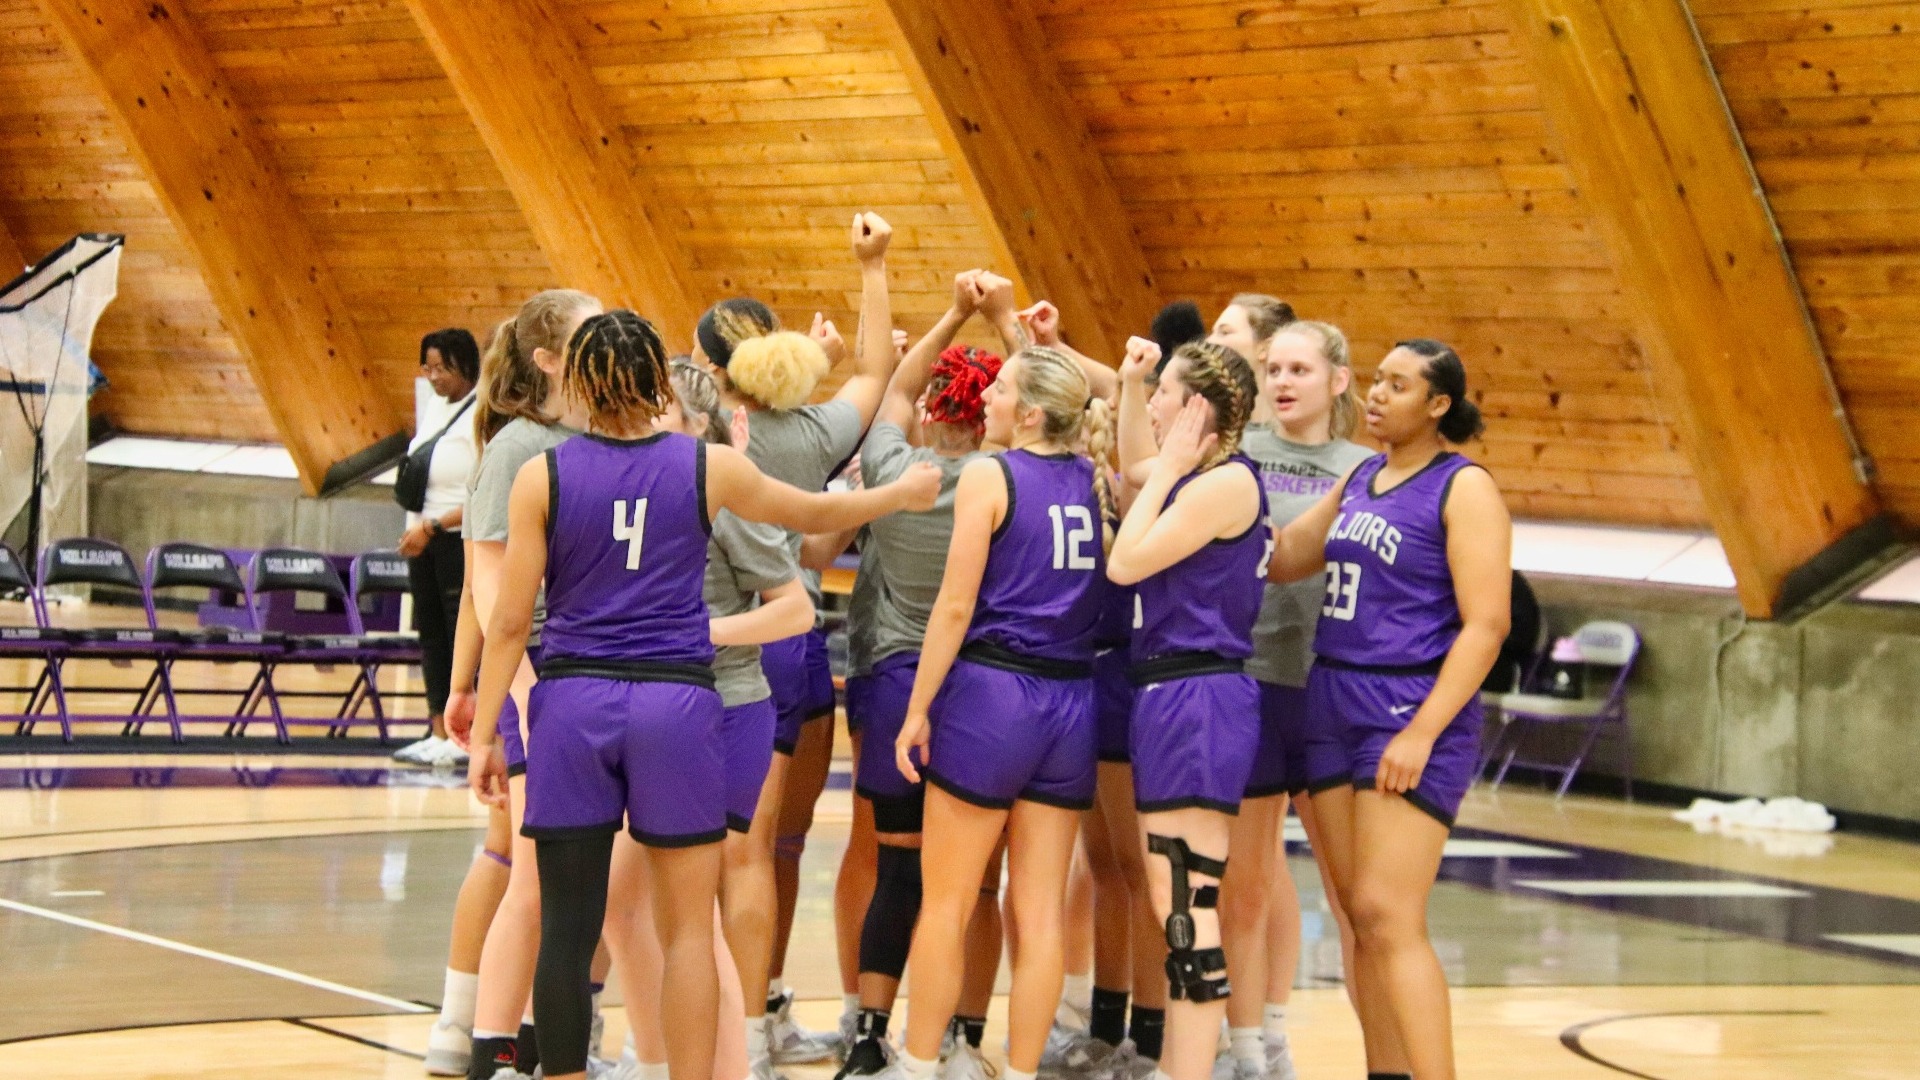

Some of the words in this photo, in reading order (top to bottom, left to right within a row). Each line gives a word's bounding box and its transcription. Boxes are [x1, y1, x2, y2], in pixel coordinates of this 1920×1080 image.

[1260, 461, 1317, 477] LLSAPS
[612, 497, 648, 570] 4
[1047, 504, 1096, 570] 12
[1326, 510, 1403, 566] AJORS
[366, 560, 410, 577] MILLSA
[1322, 561, 1362, 621] 33
